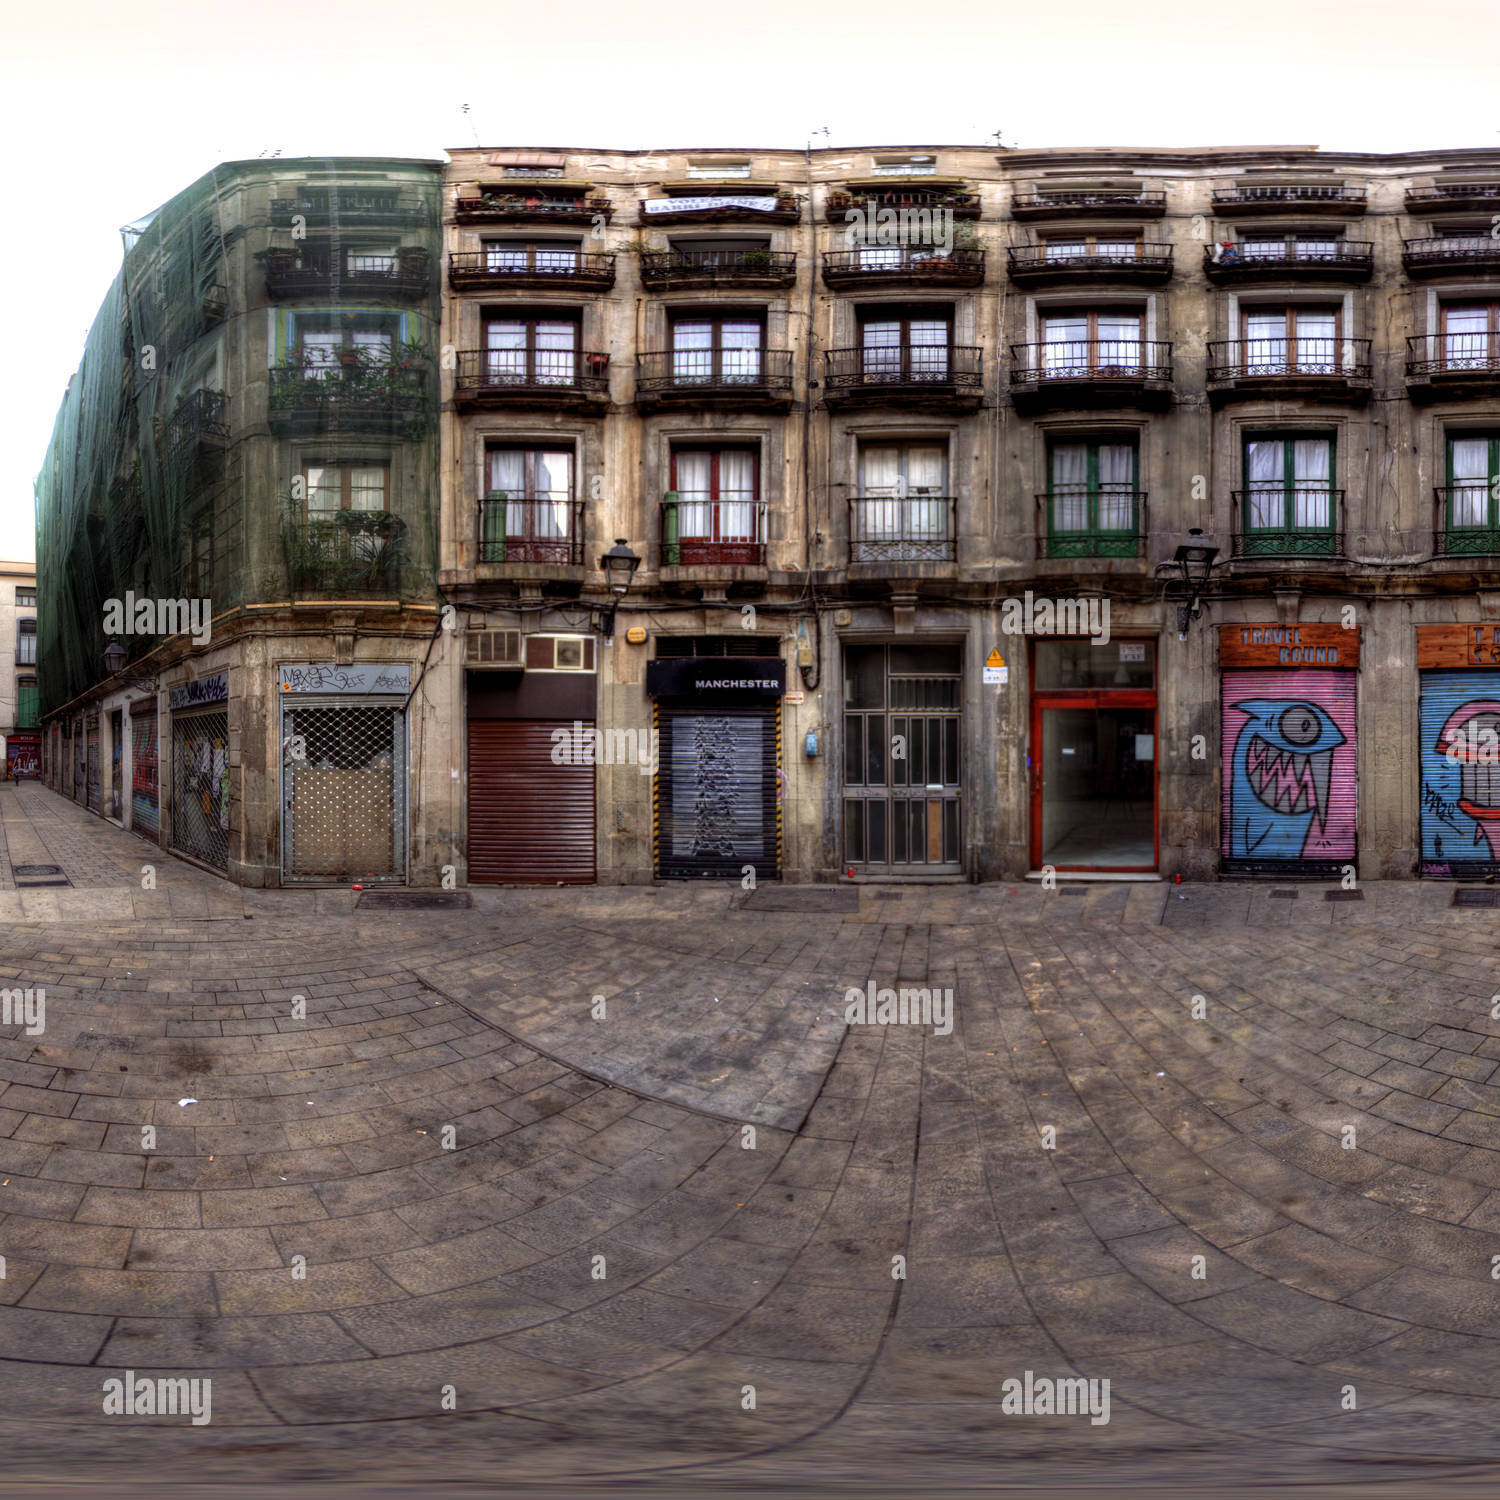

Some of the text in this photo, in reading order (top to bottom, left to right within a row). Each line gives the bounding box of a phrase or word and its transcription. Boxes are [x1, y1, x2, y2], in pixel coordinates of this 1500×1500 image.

[1240, 627, 1302, 644] TRAVEL
[1279, 646, 1338, 663] BOUND
[695, 679, 779, 689] MANCHESTER
